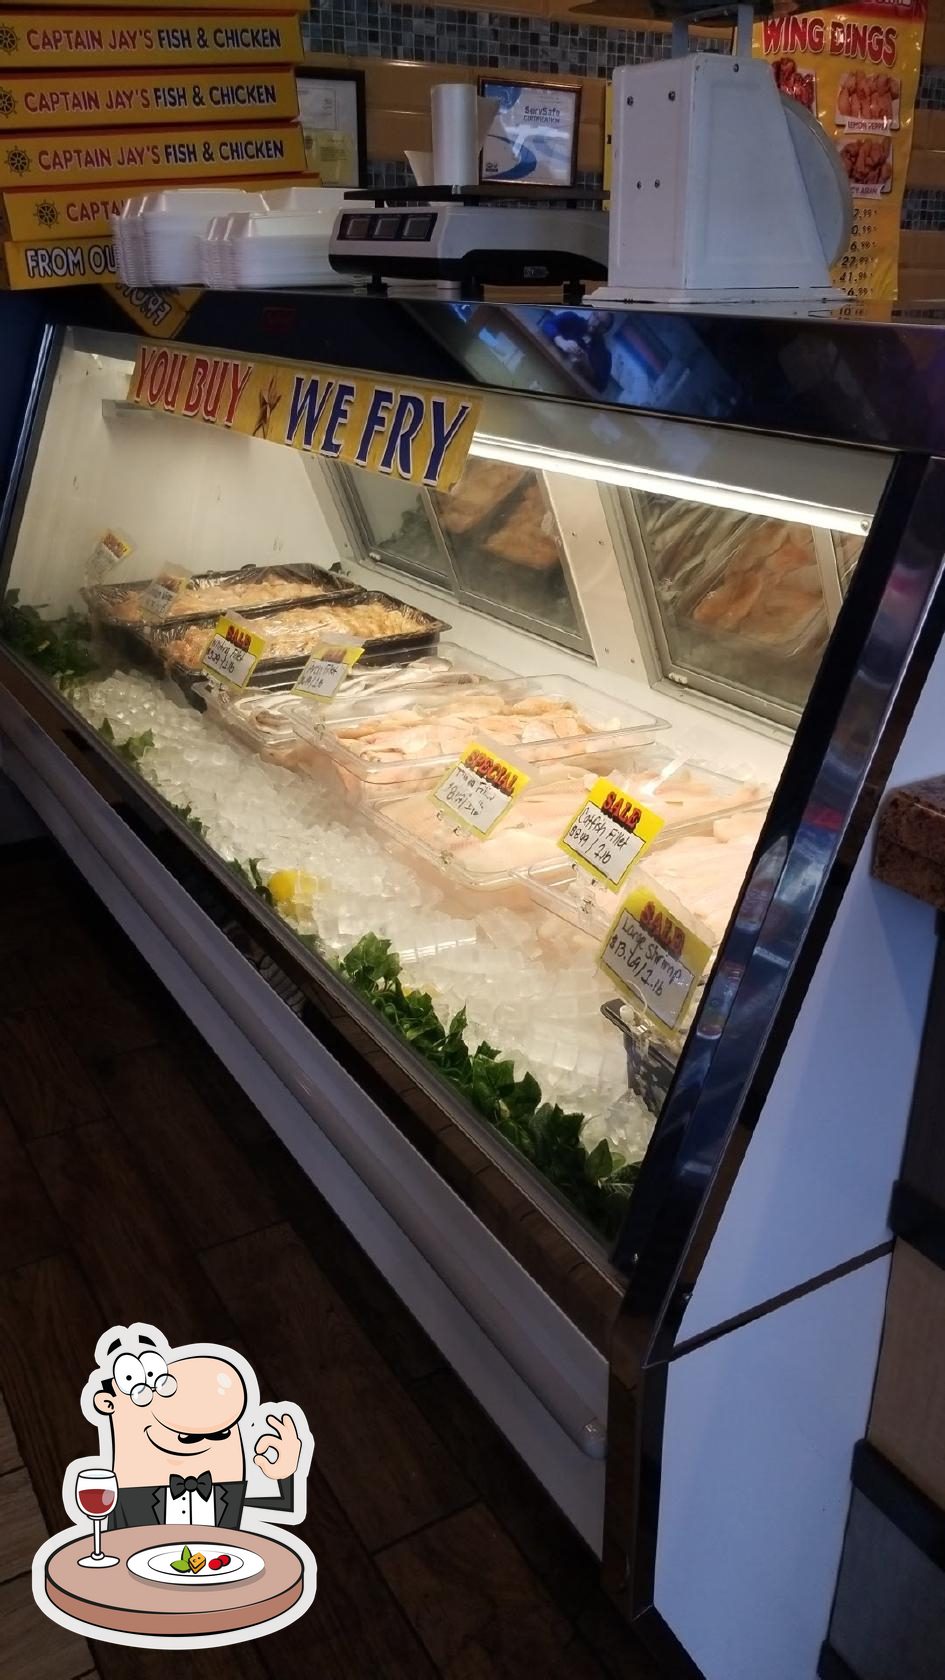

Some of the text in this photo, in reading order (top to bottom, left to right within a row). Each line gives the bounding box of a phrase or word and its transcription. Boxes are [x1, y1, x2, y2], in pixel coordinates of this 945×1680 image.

[26, 27, 282, 51] CAPTAIN JAY'S FISH & CHICKEN
[762, 17, 897, 68] WING DINGS
[24, 84, 277, 113] CAPTAIN JAY'S FISH & CHICKEN
[38, 148, 112, 171] CAPTAIN
[117, 145, 160, 166] JAY'S
[164, 143, 198, 165] FISH
[202, 140, 215, 162] &
[219, 139, 284, 161] CHICKEN
[25, 245, 84, 279] FROM
[133, 347, 472, 486] YOU BUY WE FRY
[465, 749, 518, 797] SPECIAL
[600, 791, 642, 834] SALE
[622, 917, 682, 984] Large Shrimp
